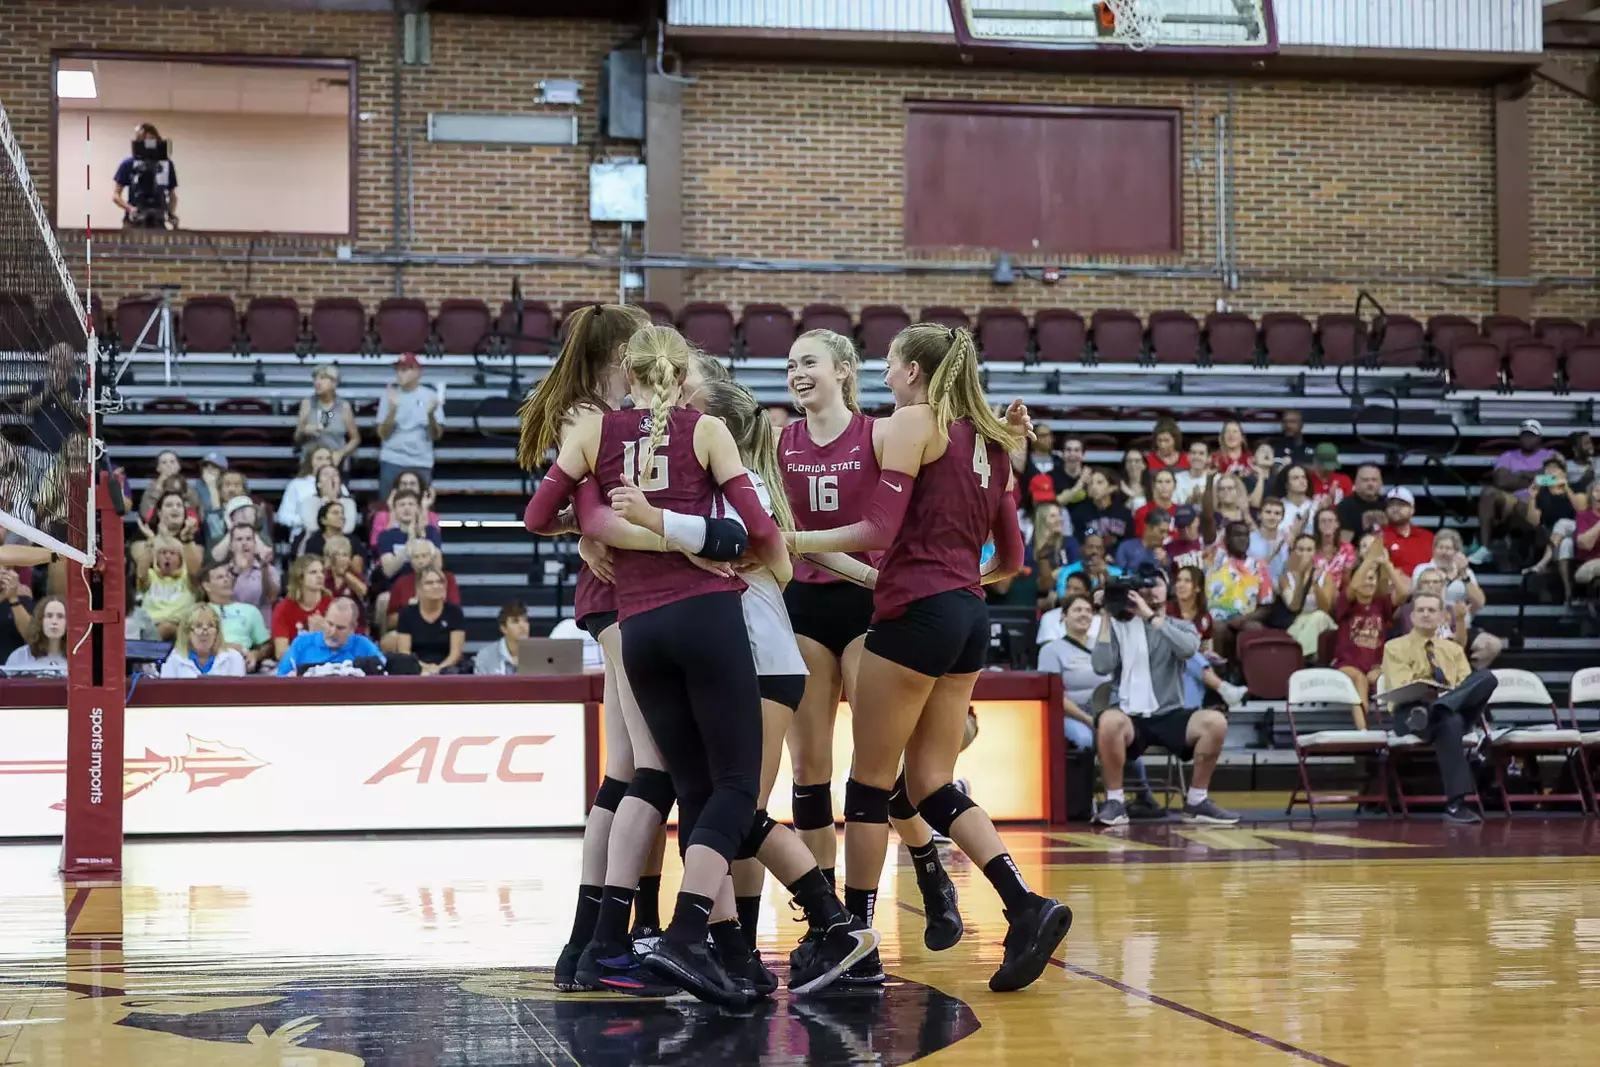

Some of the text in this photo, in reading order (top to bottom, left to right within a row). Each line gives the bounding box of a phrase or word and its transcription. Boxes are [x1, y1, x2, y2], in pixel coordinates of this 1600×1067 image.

[787, 461, 860, 472] FLORIDA STATE
[972, 433, 991, 488] 4
[806, 475, 838, 511] 16
[89, 707, 103, 804] sports imports
[363, 735, 556, 784] ACC
